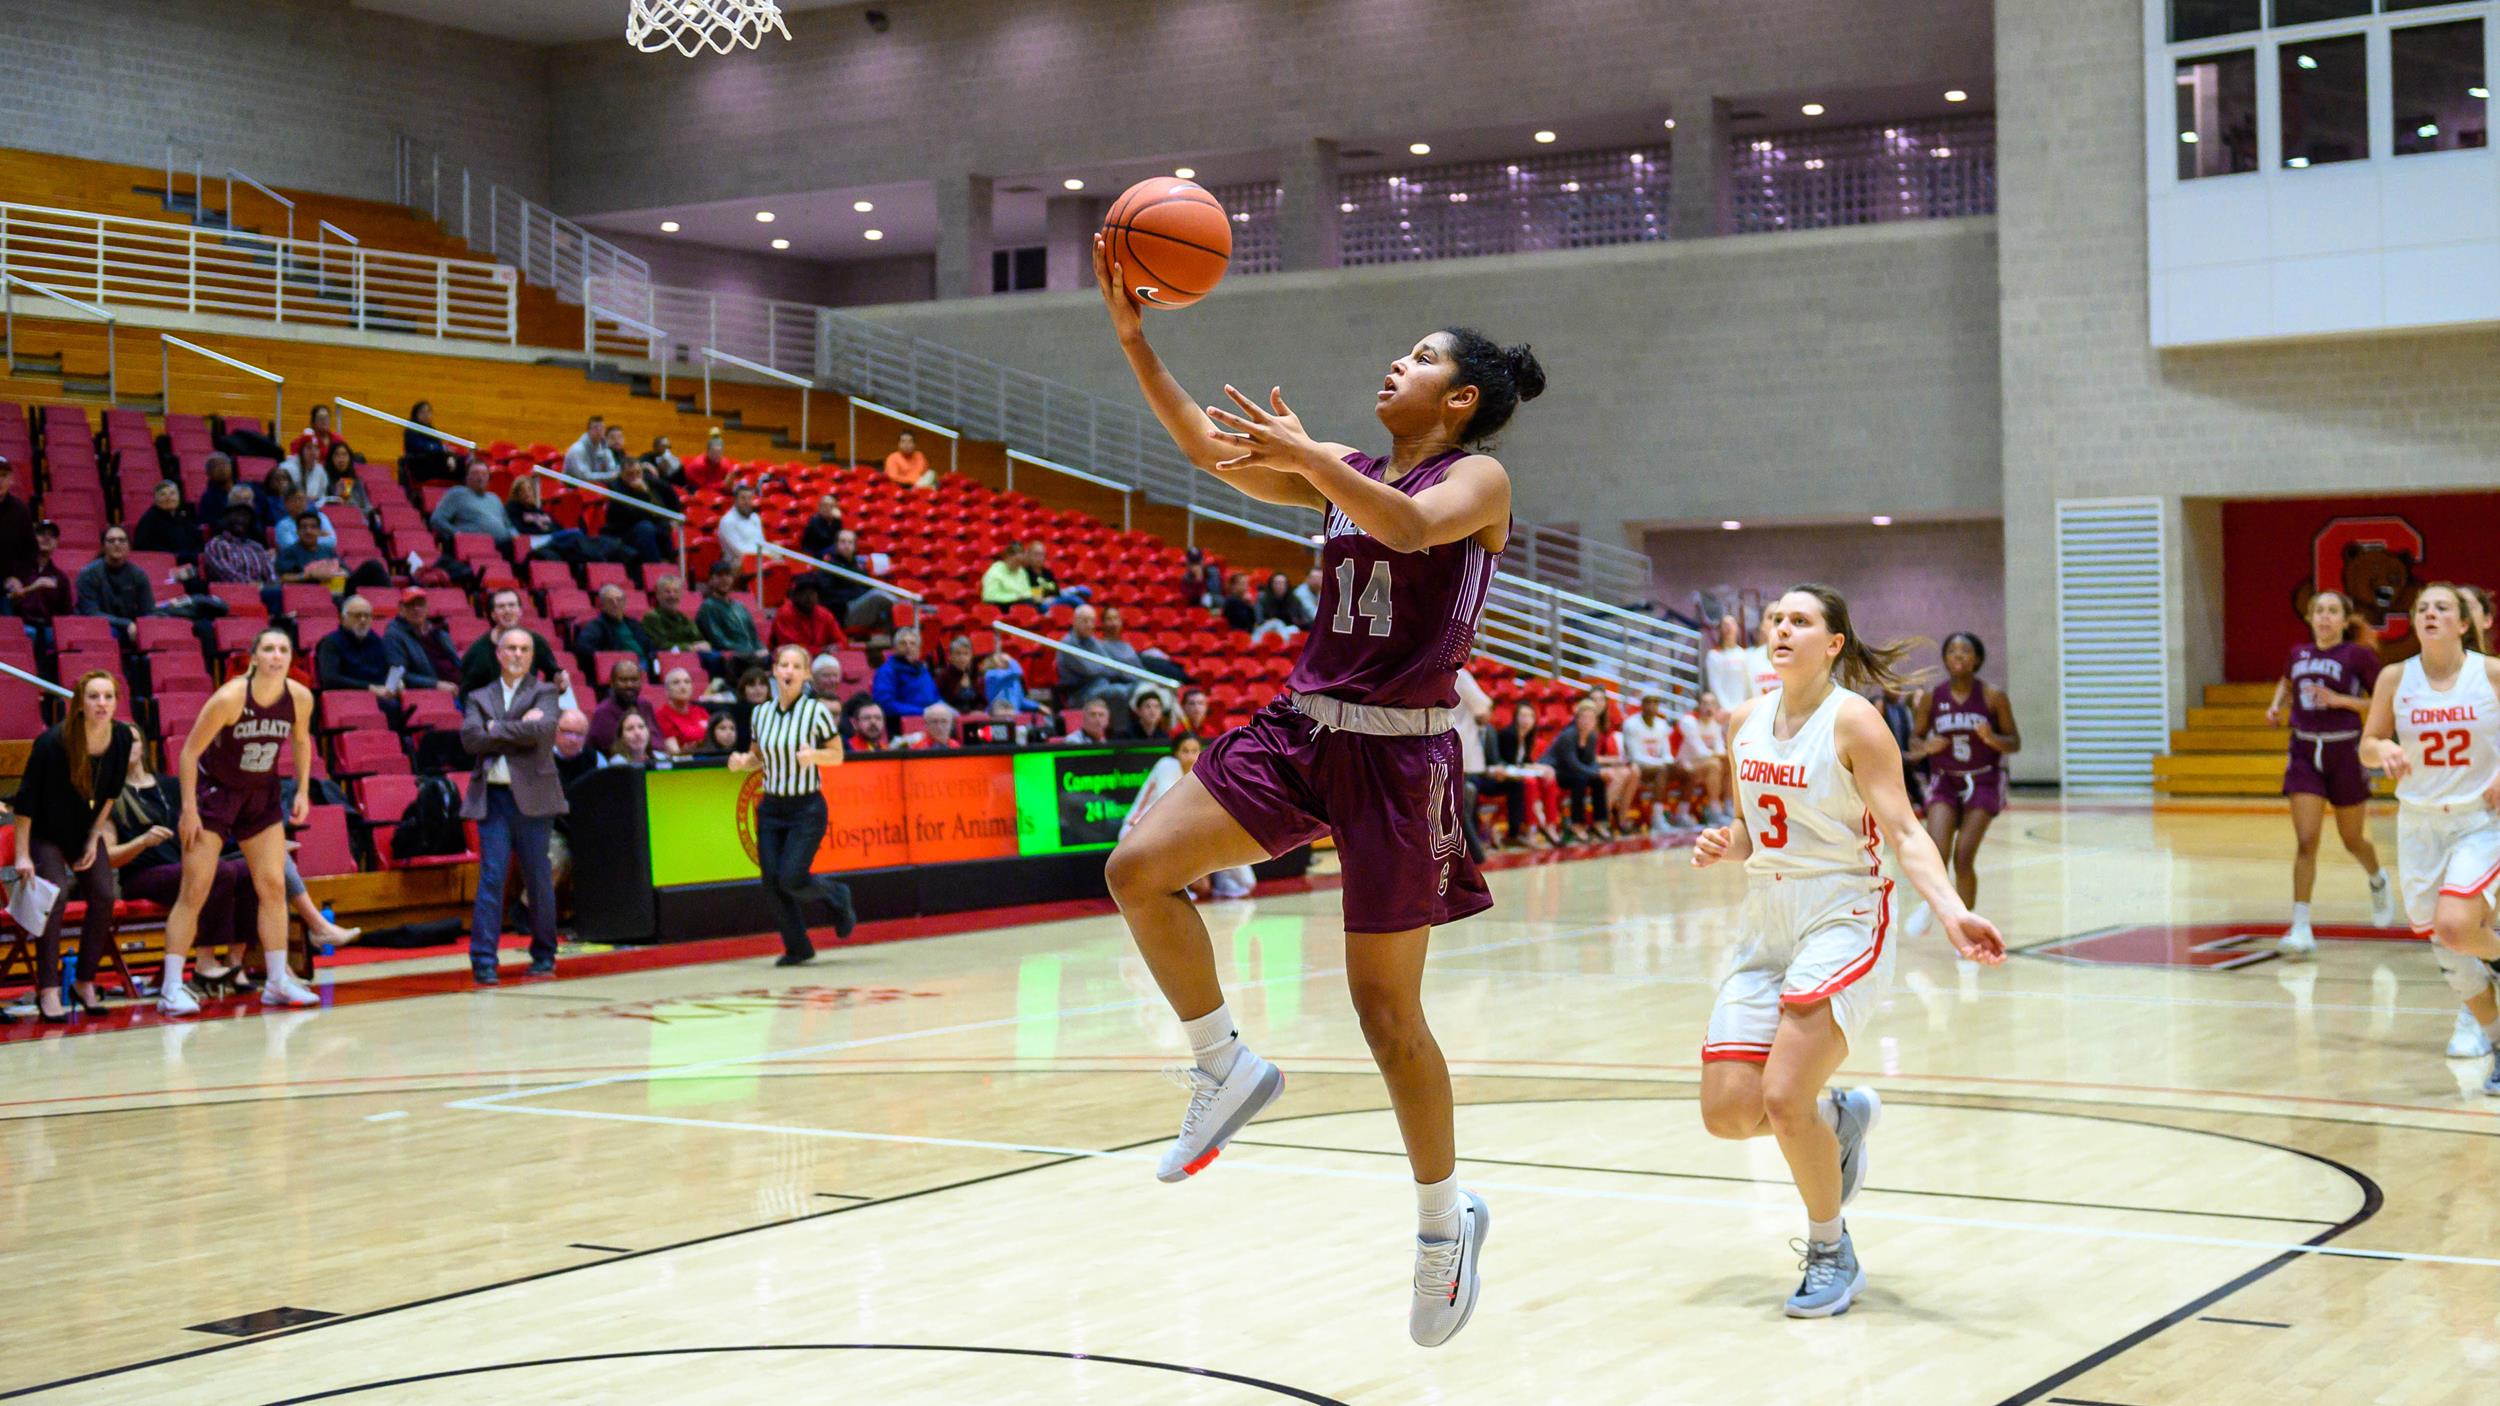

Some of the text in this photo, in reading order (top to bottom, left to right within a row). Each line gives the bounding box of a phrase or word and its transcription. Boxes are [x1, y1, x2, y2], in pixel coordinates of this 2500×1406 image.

[1332, 557, 1392, 637] 14
[2411, 705, 2477, 725] CORNELL
[1952, 734, 1971, 763] 5
[2419, 729, 2471, 767] 22
[1740, 759, 1808, 788] CORNELL
[916, 812, 945, 843] for
[952, 807, 1036, 840] Animals
[1758, 794, 1788, 848] 3
